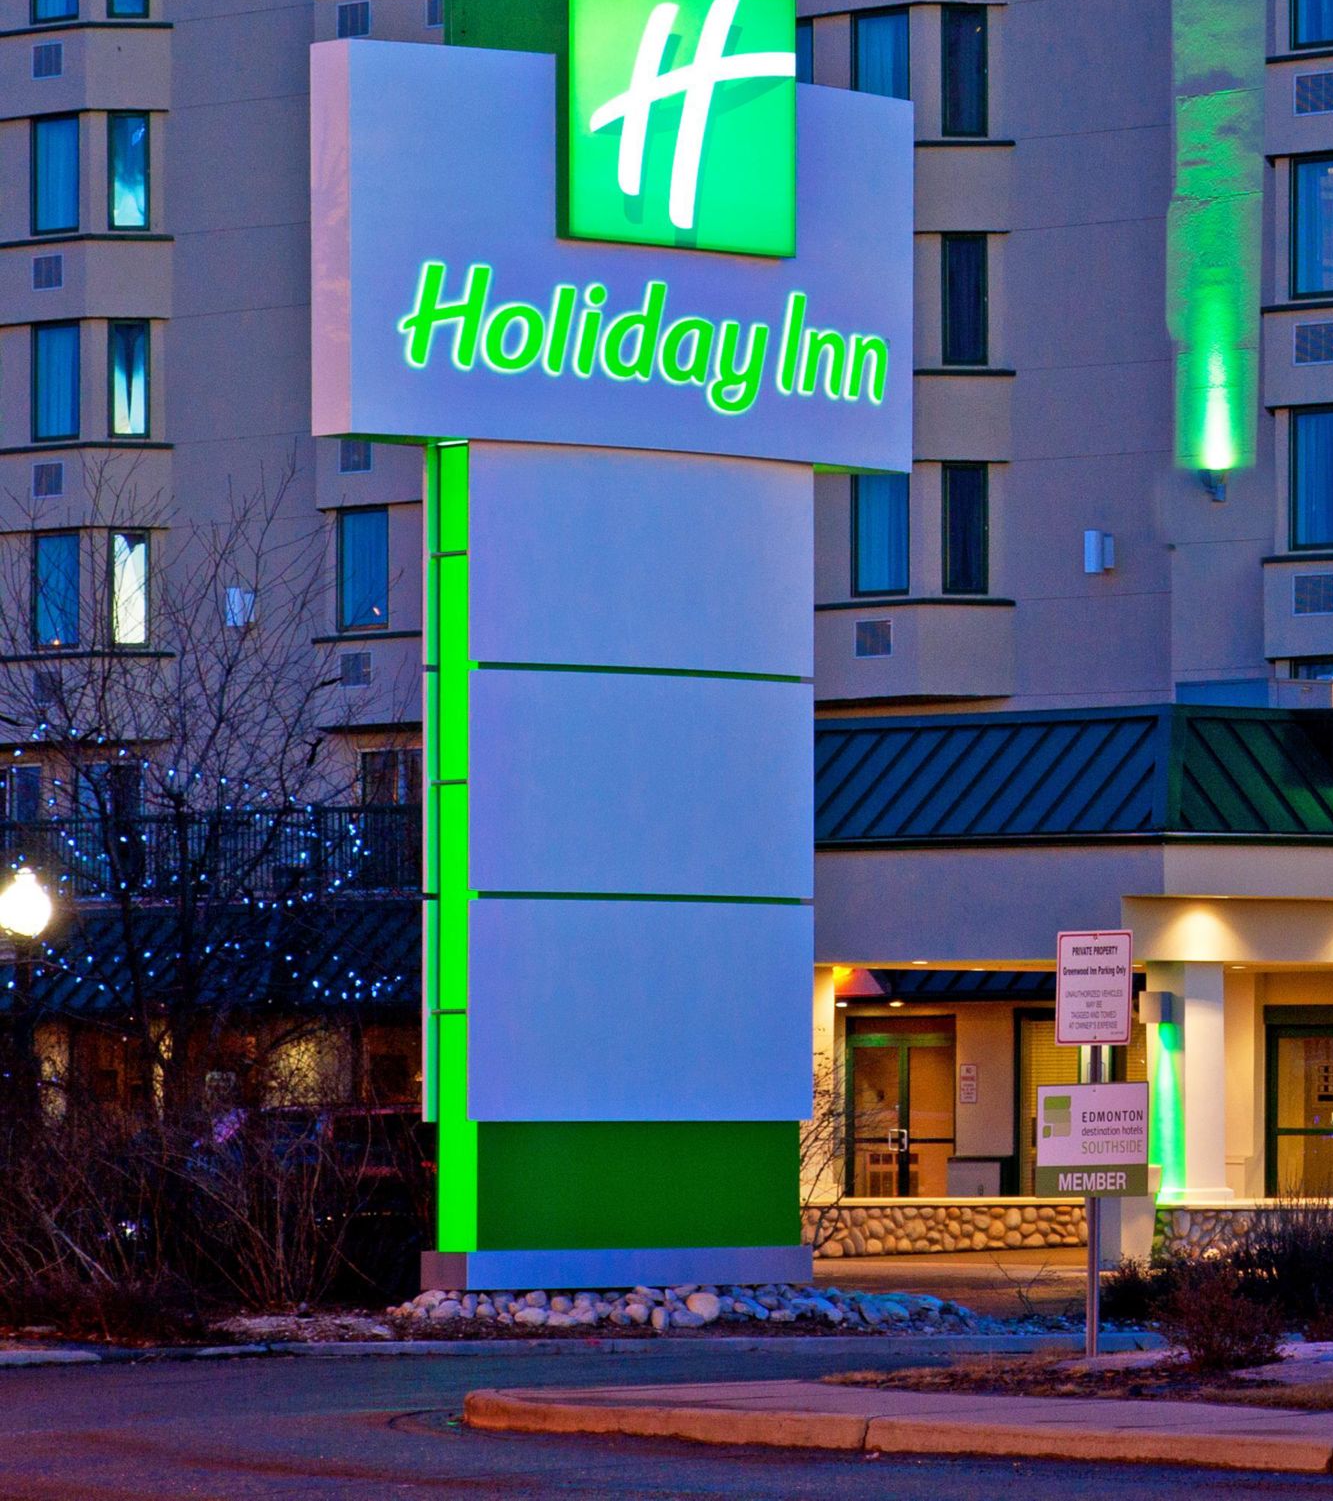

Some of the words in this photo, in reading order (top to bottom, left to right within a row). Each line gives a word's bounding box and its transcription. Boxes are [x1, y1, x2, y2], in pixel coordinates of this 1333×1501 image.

[399, 260, 769, 414] Holiday
[775, 291, 889, 405] Inn
[1072, 946, 1092, 956] PRIVATE
[1093, 945, 1118, 955] PROPERTY
[1063, 966, 1089, 976] Greenwood
[1098, 966, 1115, 977] Parking
[1116, 965, 1126, 976] Only
[1081, 1110, 1144, 1123] EDMONTON
[1081, 1127, 1121, 1137] destination
[1122, 1126, 1143, 1136] hotels
[1081, 1139, 1143, 1155] SOUTHSIDE
[1058, 1171, 1127, 1192] MEMBER
